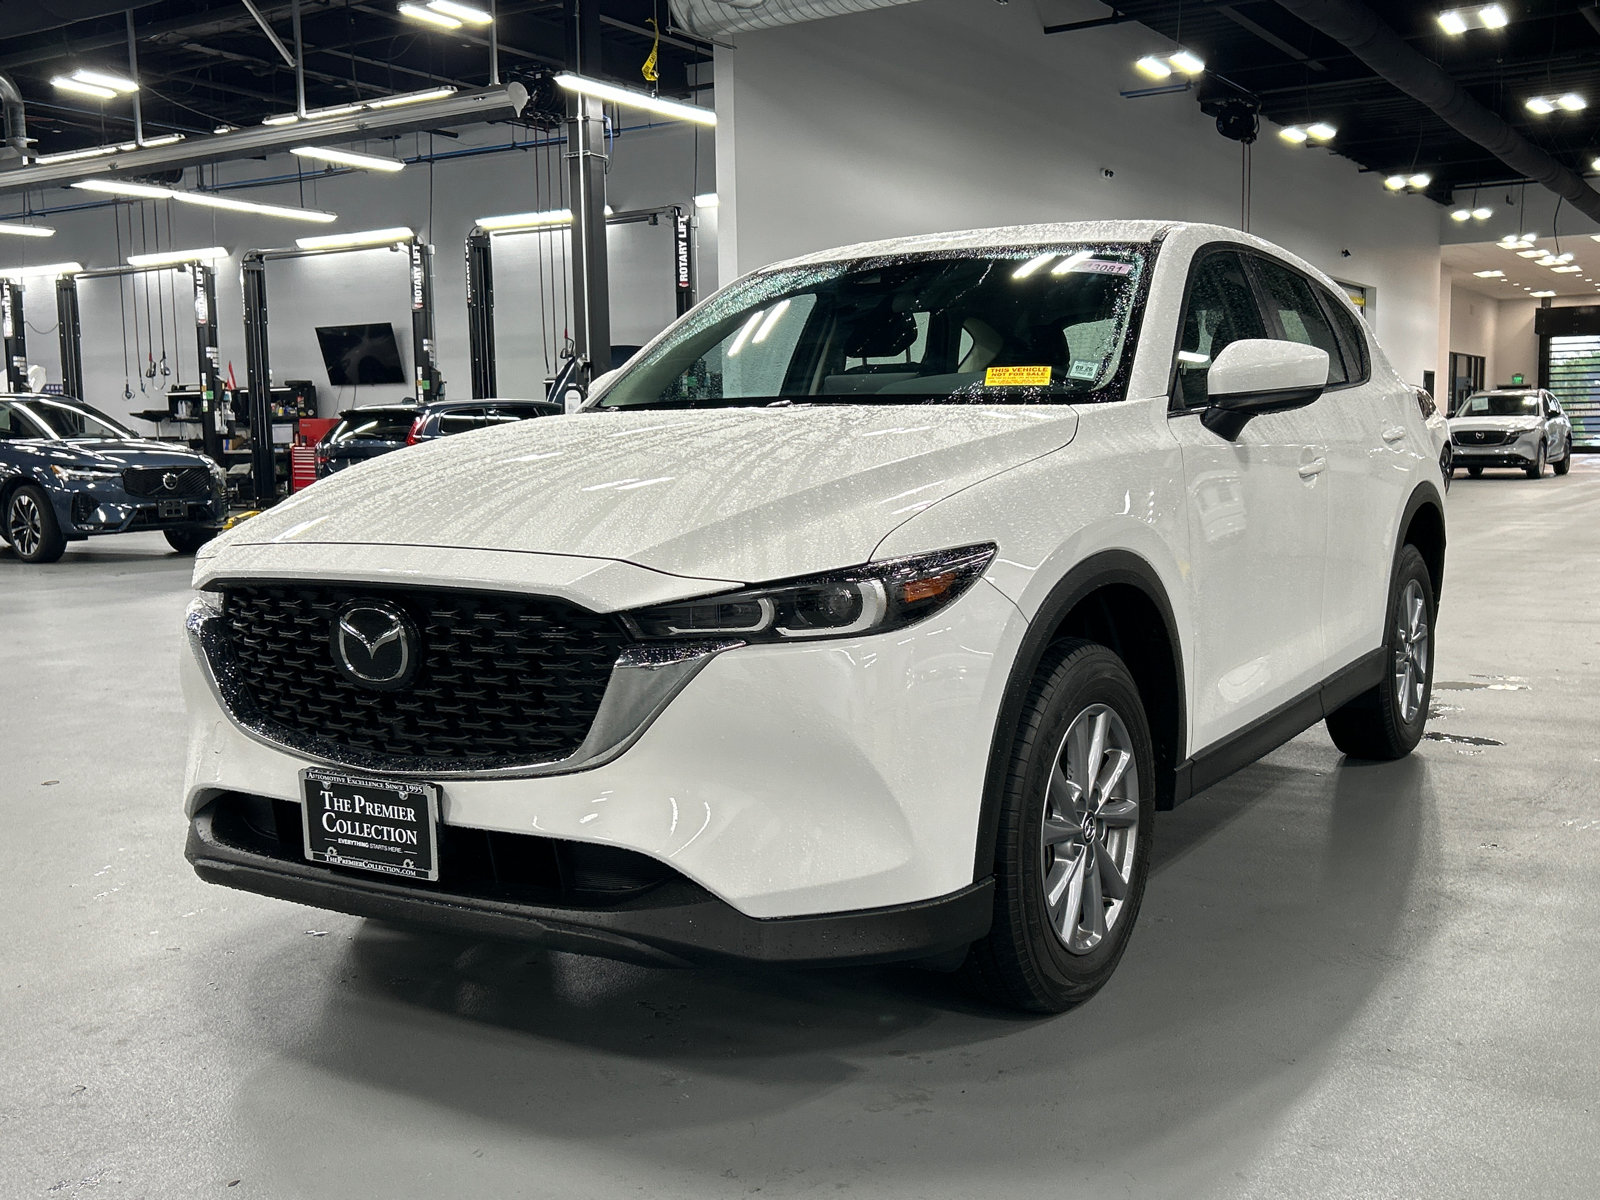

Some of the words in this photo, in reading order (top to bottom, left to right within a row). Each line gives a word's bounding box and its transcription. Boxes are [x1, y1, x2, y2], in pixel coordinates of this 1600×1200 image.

[677, 215, 689, 238] LIFT
[412, 244, 421, 265] LIFT
[678, 240, 688, 282] ROTARY
[195, 267, 204, 285] LIFT
[413, 266, 422, 303] ROTARY
[405, 784, 423, 794] 1995
[320, 790, 352, 813] THE
[353, 794, 417, 822] PREMIER
[321, 811, 418, 845] COLLECTION
[337, 837, 370, 848] EVERYTHING
[369, 843, 388, 851] STARTS
